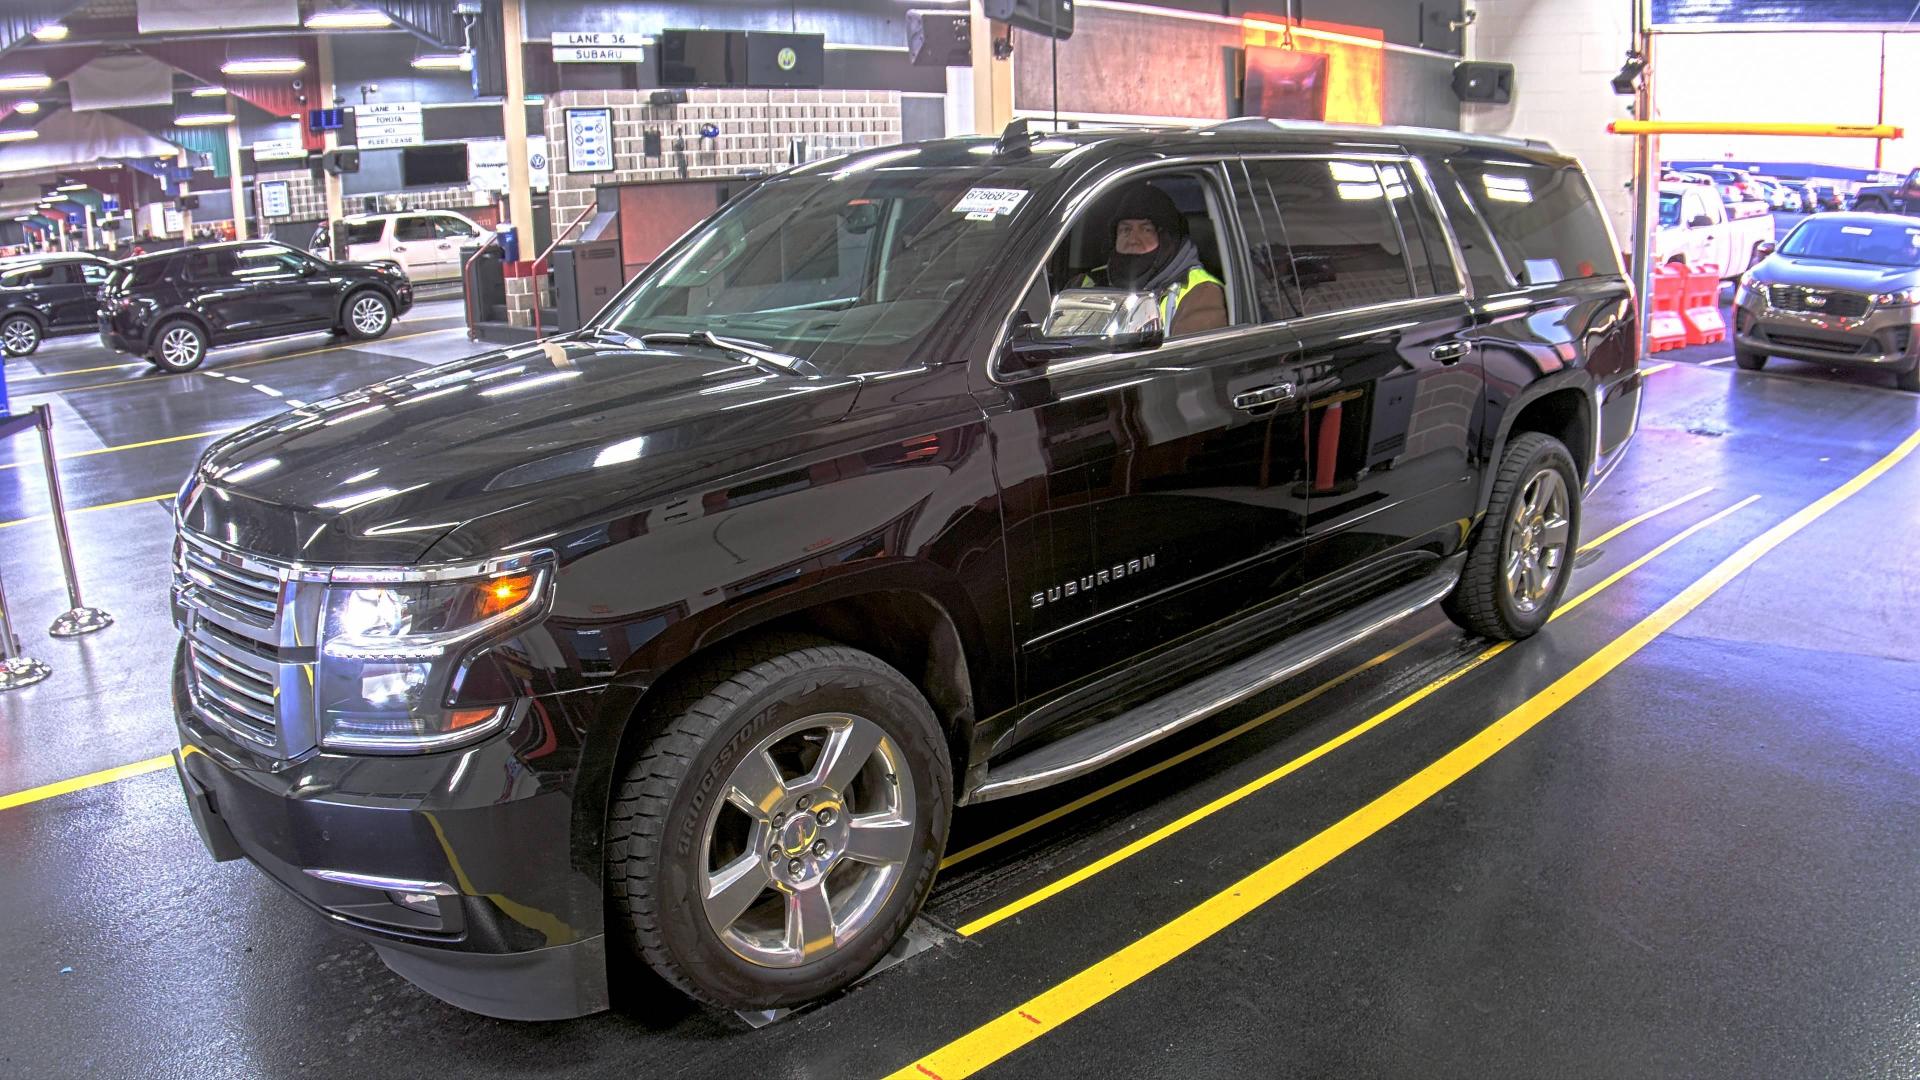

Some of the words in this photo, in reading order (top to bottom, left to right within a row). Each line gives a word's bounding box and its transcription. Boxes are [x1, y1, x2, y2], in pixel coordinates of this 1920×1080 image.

[568, 34, 600, 44] LANE
[611, 34, 626, 44] 36
[575, 49, 623, 60] SUBARU
[370, 105, 390, 113] LANE
[376, 115, 403, 124] TOYOTA
[390, 136, 413, 144] LEASE
[966, 190, 1020, 202] 6786872
[1031, 553, 1156, 610] SUBURBAN
[677, 702, 778, 853] BRIDGESTONE
